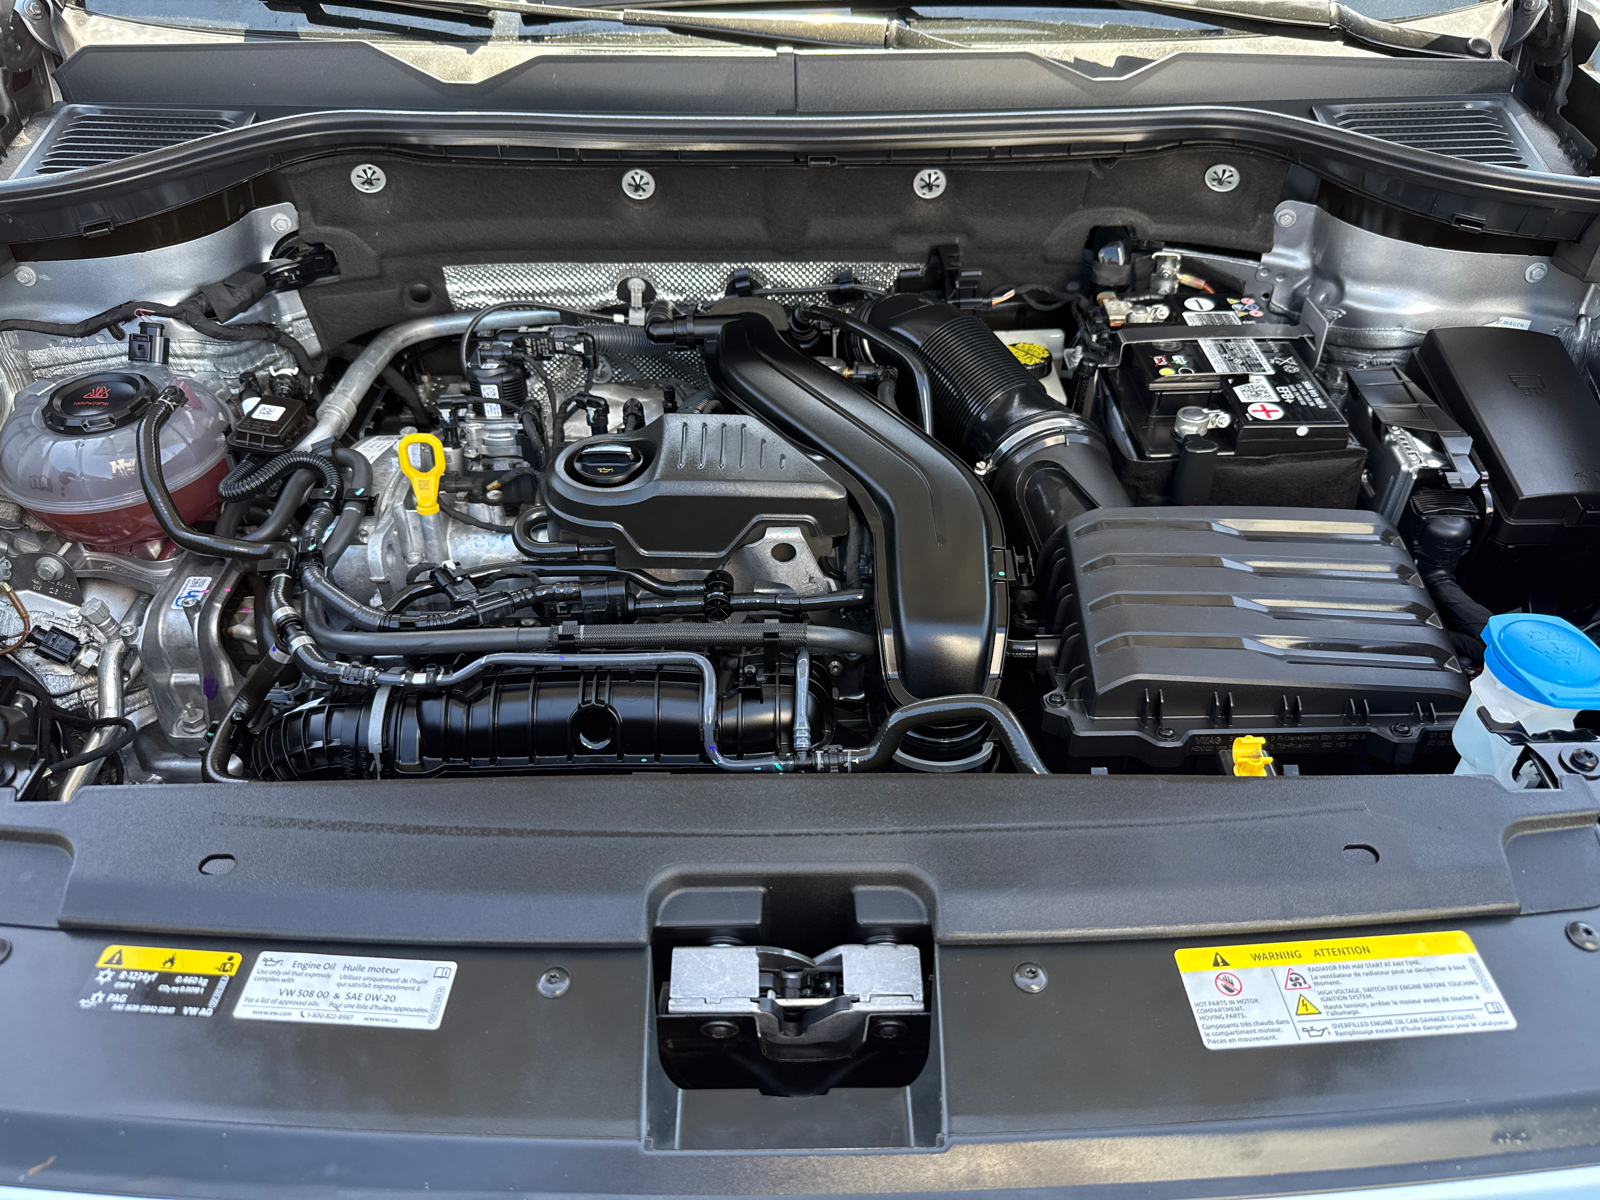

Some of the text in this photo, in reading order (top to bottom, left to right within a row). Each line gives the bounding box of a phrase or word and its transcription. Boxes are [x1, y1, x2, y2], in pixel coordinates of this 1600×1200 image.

[1250, 946, 1371, 961] WARNING ATTENTION
[292, 961, 322, 970] Engine
[343, 964, 366, 972] Huile
[118, 971, 158, 984] R-1234yf
[198, 978, 209, 987] kg
[106, 993, 128, 1003] PAG
[279, 988, 296, 997] VW
[297, 989, 315, 998] 508
[316, 990, 330, 998] 00
[345, 992, 363, 1000] SAE
[364, 994, 396, 1002] 0W-20
[183, 1006, 213, 1017] VW AG
